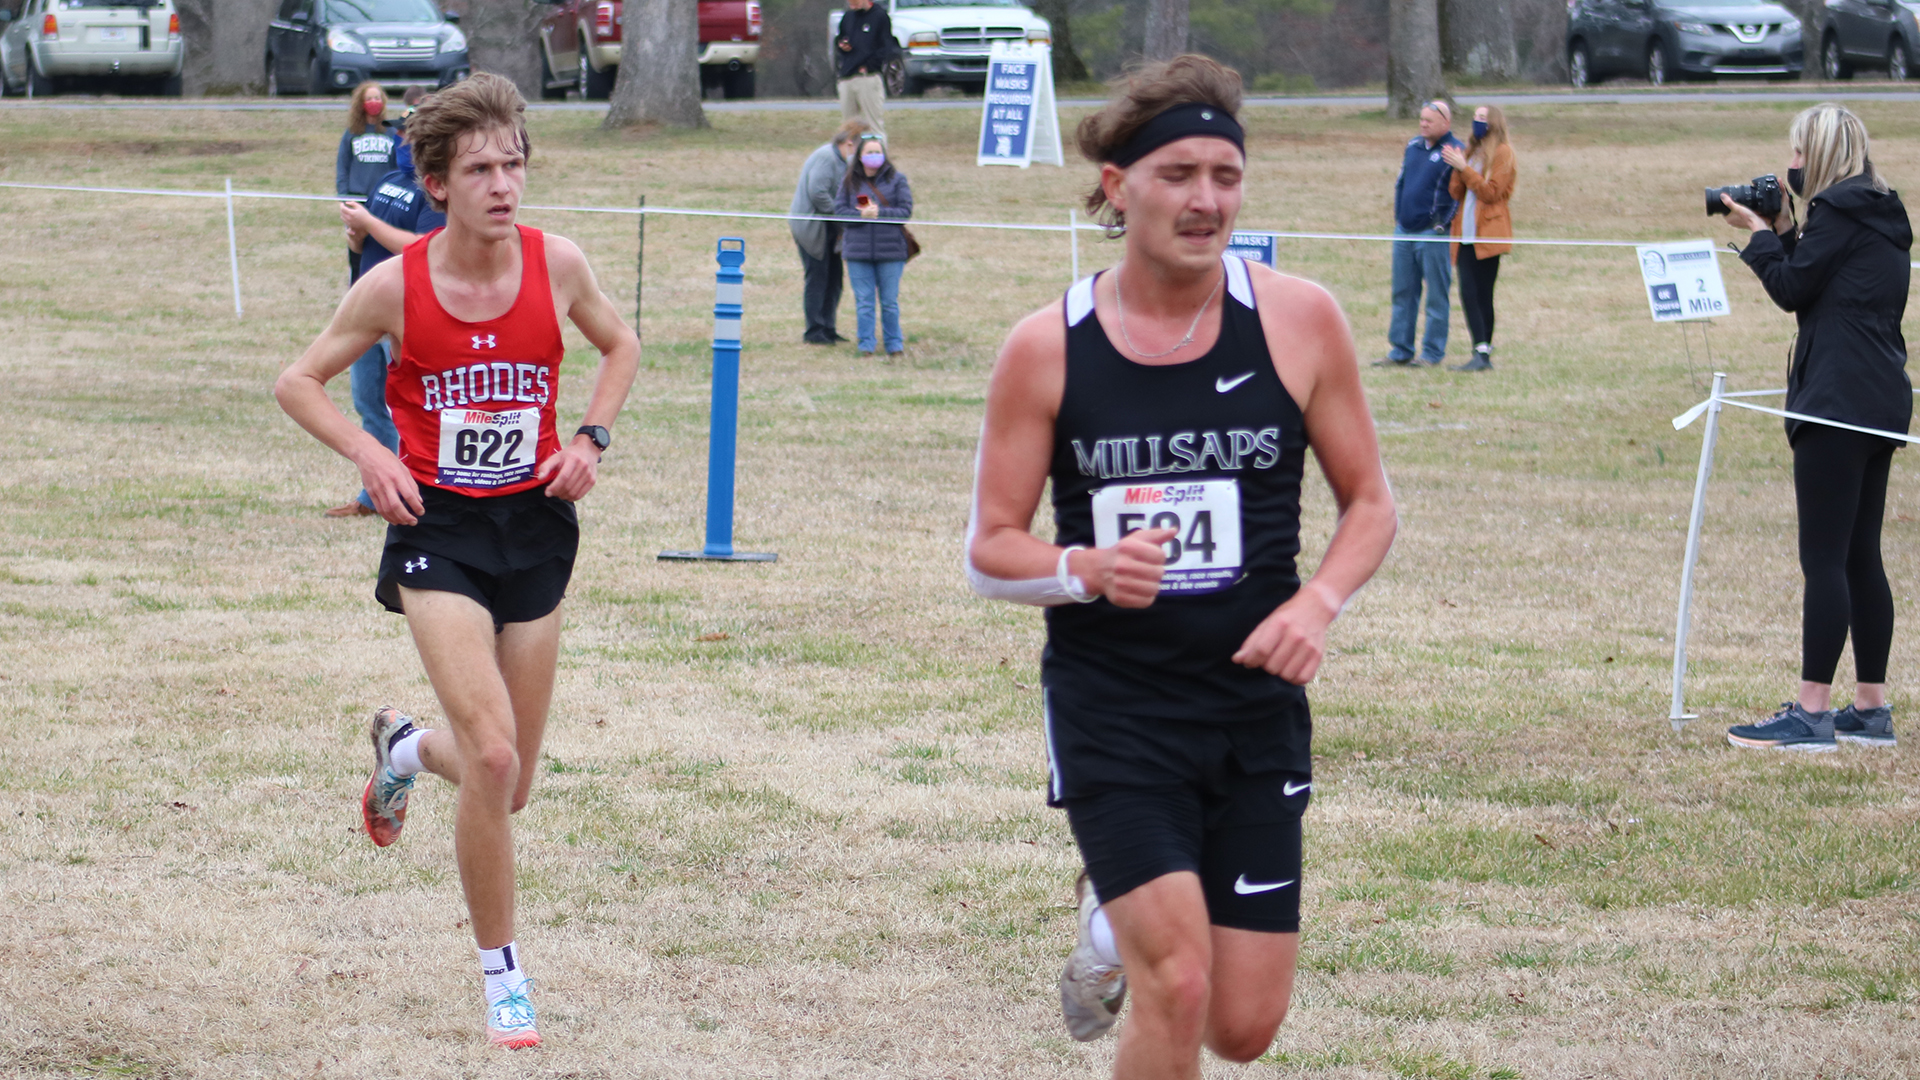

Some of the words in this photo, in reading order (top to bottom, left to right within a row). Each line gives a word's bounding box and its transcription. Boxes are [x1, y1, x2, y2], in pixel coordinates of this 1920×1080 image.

[1001, 64, 1027, 75] FACE
[995, 78, 1029, 91] MASKS
[988, 93, 1032, 105] REQUIRED
[992, 108, 1006, 120] AT
[1006, 109, 1023, 121] ALL
[992, 123, 1020, 136] TIMES
[352, 134, 394, 155] BERRY
[358, 153, 389, 163] VIKINGS
[1234, 235, 1269, 247] MASKS
[1696, 278, 1706, 292] 2
[1689, 297, 1722, 313] Mile
[421, 362, 549, 411] RHODES
[463, 411, 522, 427] MileSplit
[455, 428, 524, 468] 622
[1071, 428, 1280, 479] MILLSAPS
[1124, 484, 1205, 506] MileSplit
[1161, 573, 1188, 582] nkings,
[1189, 572, 1206, 580] race
